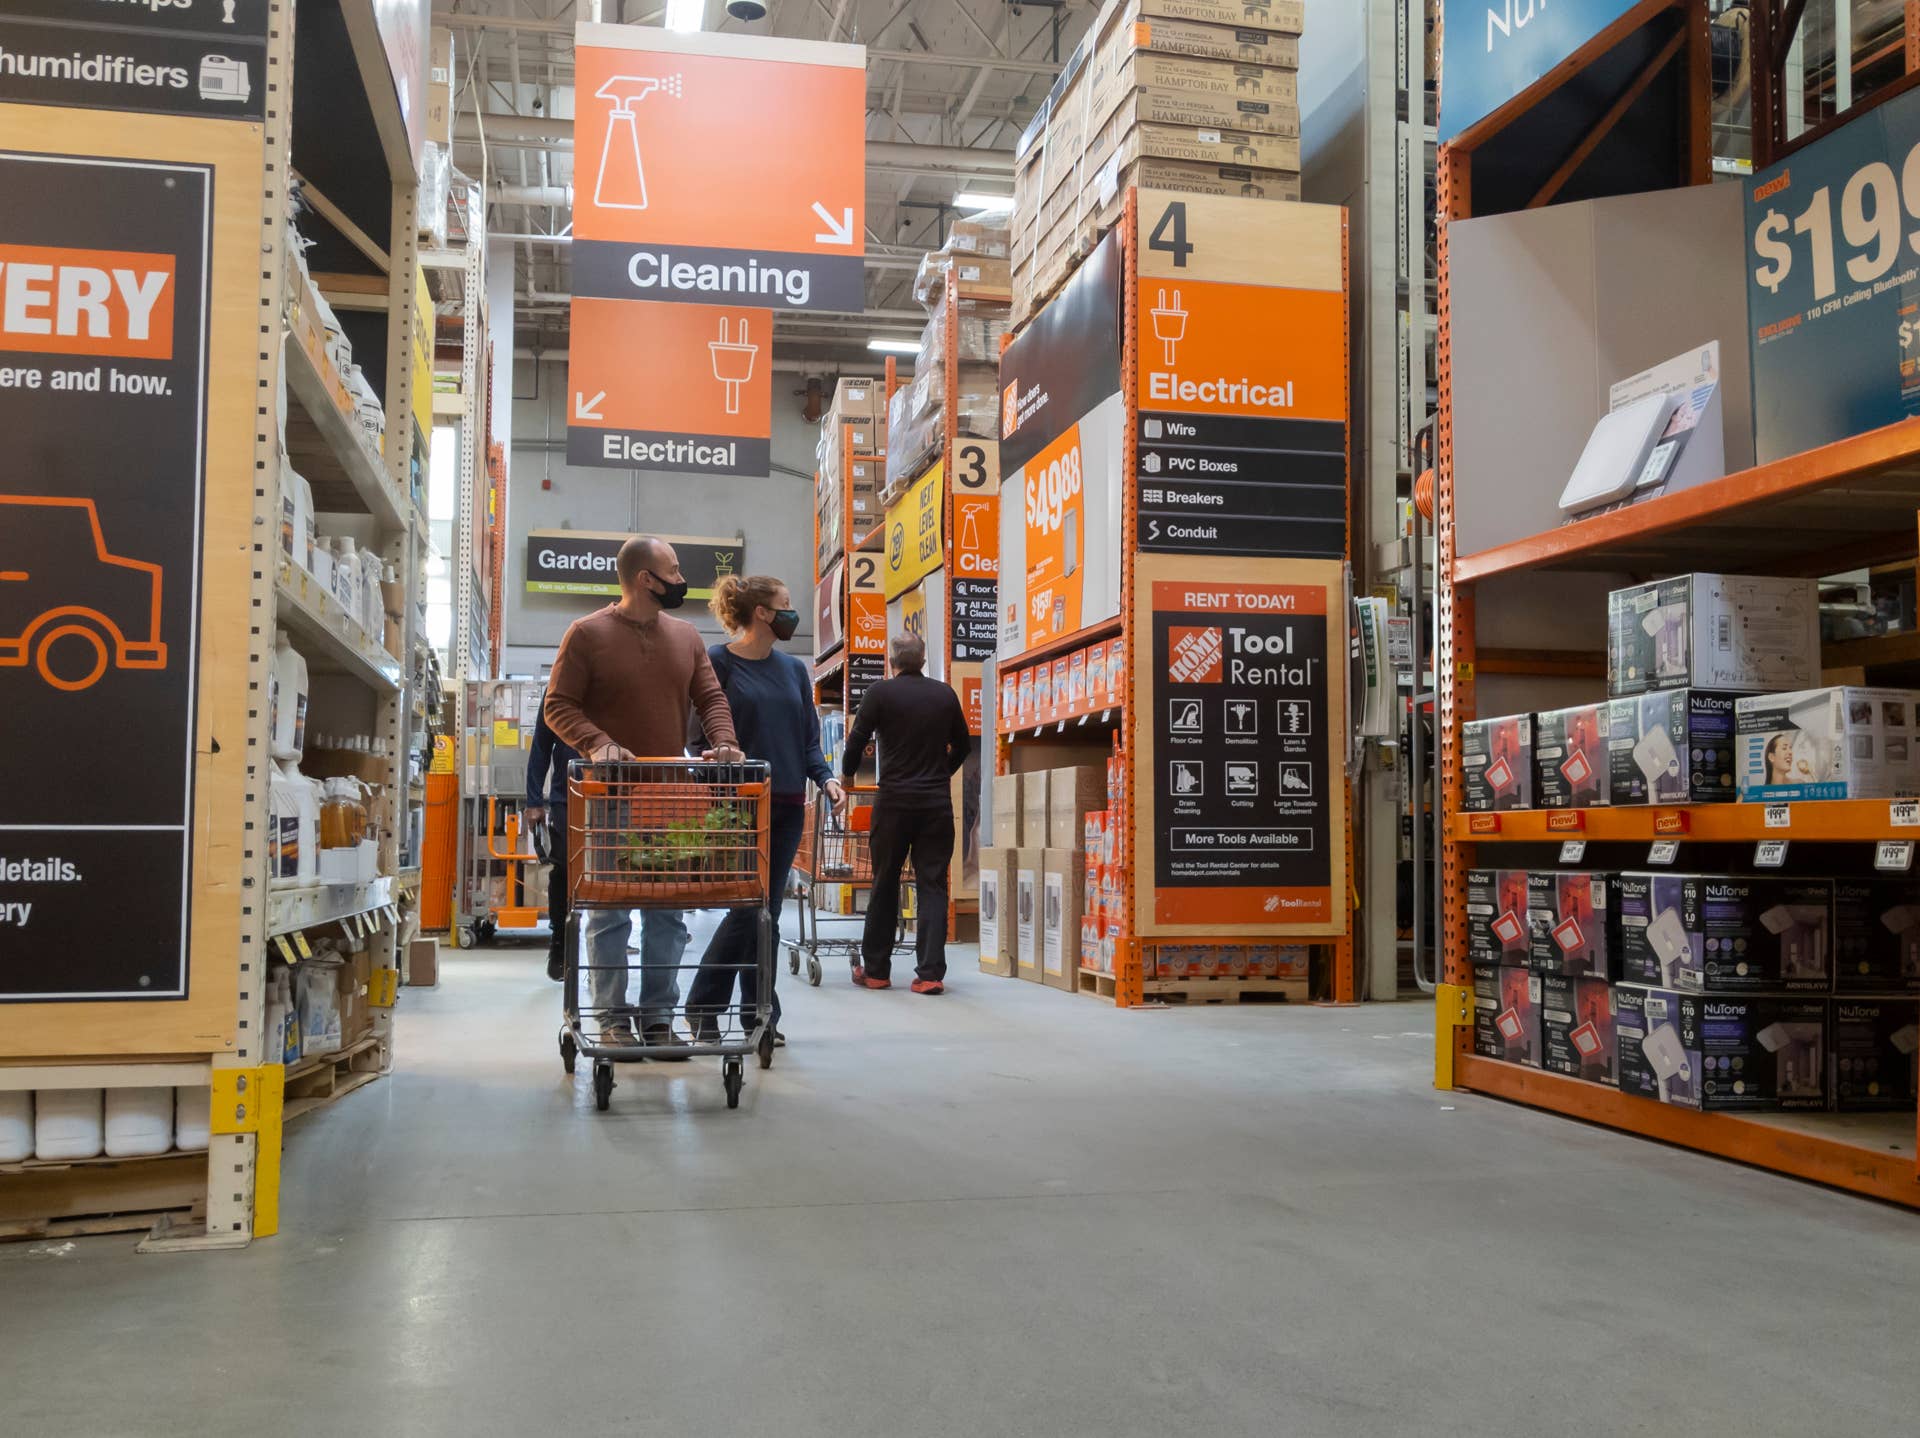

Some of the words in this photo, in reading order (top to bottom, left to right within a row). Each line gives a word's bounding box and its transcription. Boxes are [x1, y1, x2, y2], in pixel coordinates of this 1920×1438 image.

[1163, 3, 1216, 19] HAMPTON
[1218, 8, 1237, 21] BAY
[1486, 0, 1546, 53] Nu
[1151, 39, 1208, 56] HAMPTON
[1211, 47, 1233, 58] BAY
[1155, 74, 1209, 91] HAMPTON
[1210, 80, 1230, 92] BAY
[1151, 110, 1211, 125] HAMPTON
[1213, 118, 1233, 128] BAY
[1144, 144, 1199, 160] HAMPTON
[1201, 150, 1220, 161] BAY
[1149, 201, 1194, 267] 4
[627, 252, 811, 305] Cleaning
[0, 262, 170, 341] ERY
[1807, 306, 1821, 321] 110
[1822, 298, 1842, 315] CFM
[1843, 287, 1872, 307] Ceiling
[50, 367, 101, 391] and
[108, 369, 173, 396] how.
[1149, 371, 1294, 407] Electrical
[1166, 422, 1197, 437] Wire
[602, 434, 737, 467] Electrical
[958, 445, 988, 489] 3
[1168, 458, 1196, 471] PVC
[1199, 459, 1238, 473] Boxes
[920, 480, 935, 507] NEXT
[1166, 491, 1224, 505] Breakers
[919, 505, 936, 537] LEVEL
[1167, 525, 1218, 540] Conduit
[919, 530, 937, 564] CLEAN
[538, 549, 618, 572] Garden
[855, 557, 876, 589] 2
[969, 585, 991, 594] Floor
[969, 601, 981, 610] All
[1184, 592, 1230, 608] RENT
[1234, 593, 1296, 610] TODAY!
[1174, 632, 1197, 656] THE
[1229, 626, 1293, 654] Tool
[969, 648, 994, 657] Paper
[1169, 627, 1223, 683] HOME
[1190, 648, 1223, 683] DEPOT
[1231, 658, 1311, 686] Rental
[1691, 697, 1733, 710] NuTone
[1170, 737, 1187, 745] Floor
[1225, 738, 1258, 746] Demolition
[1173, 808, 1201, 816] Cleaning
[1231, 800, 1254, 809] Cutting
[1273, 800, 1291, 809] Large
[1279, 808, 1312, 817] Equipment
[1549, 812, 1577, 827] new!
[1472, 815, 1495, 830] new!
[1655, 812, 1682, 830] new!
[1185, 834, 1214, 845] More
[1216, 834, 1247, 845] Tools
[1249, 834, 1299, 845] Available
[1170, 869, 1241, 877] homedepot.com/rentals
[1468, 874, 1489, 885] NuTone
[1527, 877, 1549, 888] NuTone
[1622, 882, 1648, 894] NuTone
[1684, 889, 1697, 899] 110
[1705, 884, 1749, 897] NuTone
[1685, 912, 1696, 923] 1.0
[1617, 992, 1644, 1005] NuTone
[1681, 1006, 1695, 1017] 110
[1703, 1002, 1747, 1015] NuTone
[1683, 1030, 1695, 1041] 1.0
